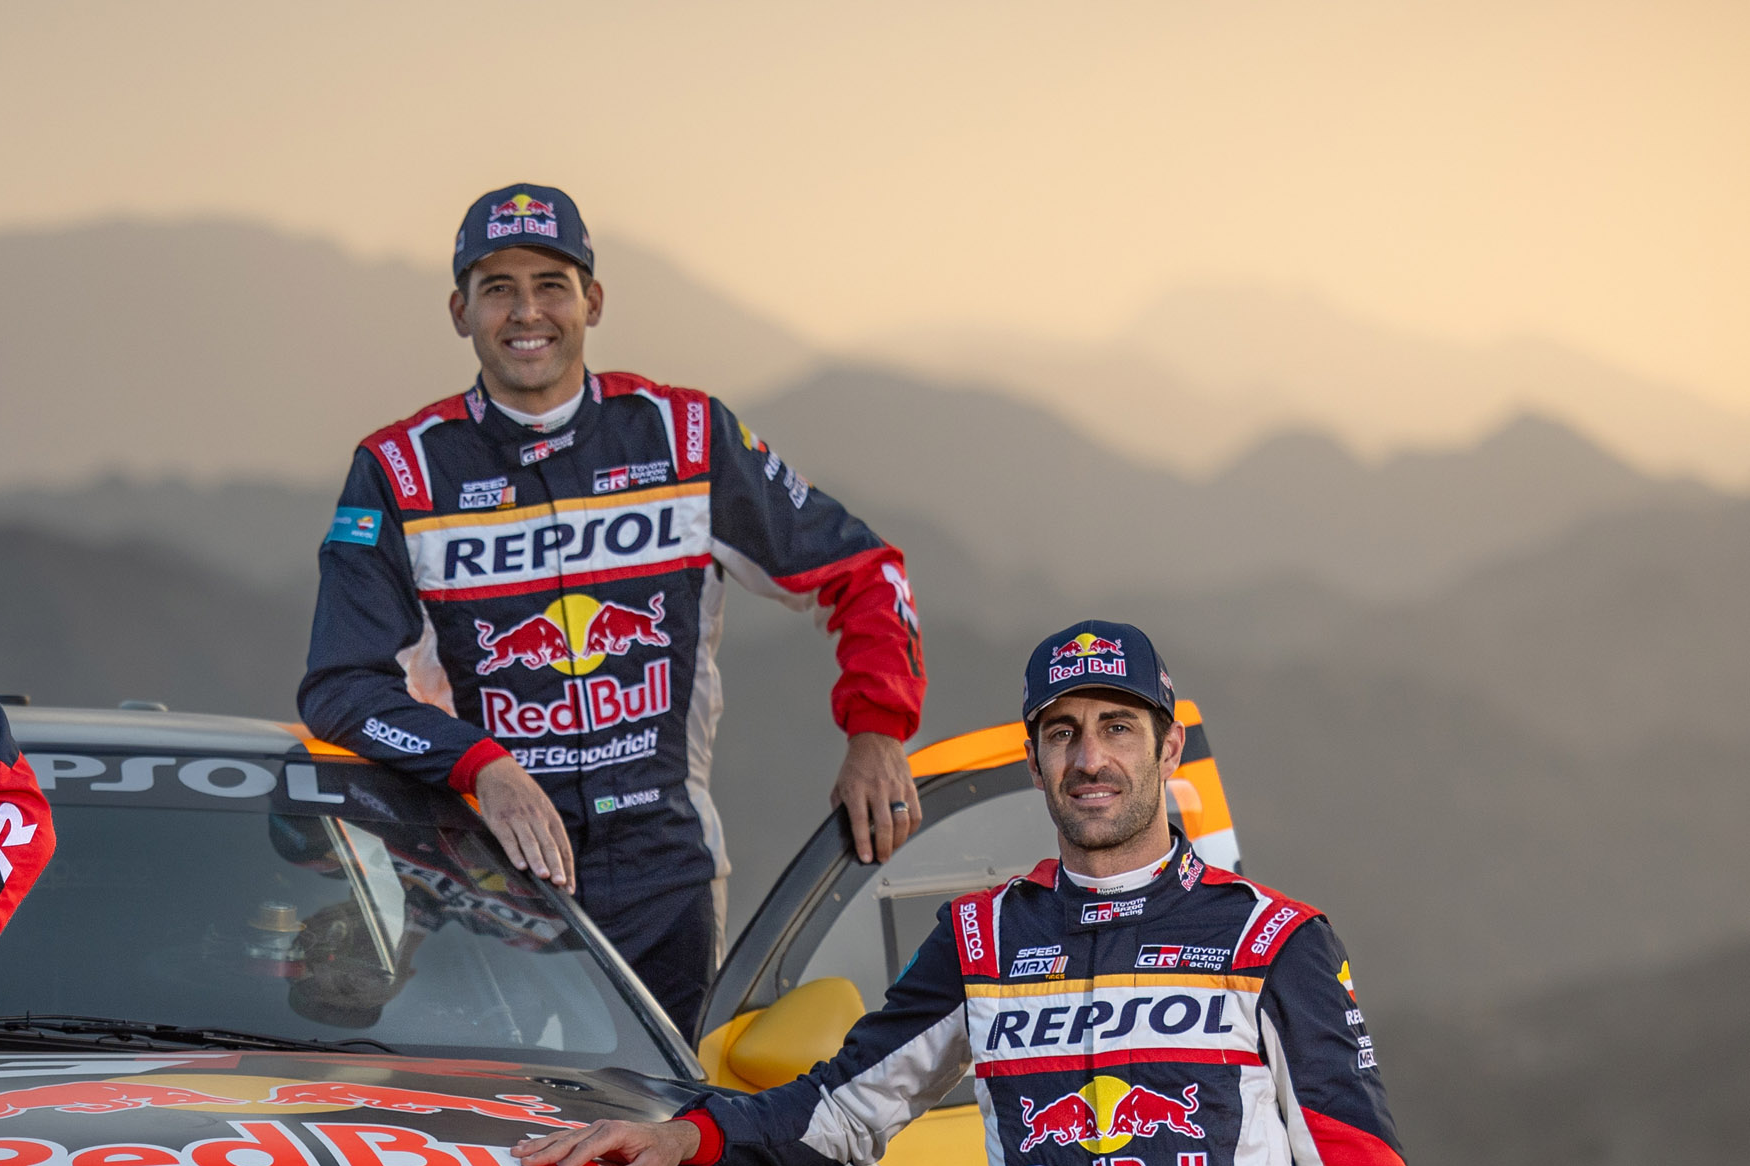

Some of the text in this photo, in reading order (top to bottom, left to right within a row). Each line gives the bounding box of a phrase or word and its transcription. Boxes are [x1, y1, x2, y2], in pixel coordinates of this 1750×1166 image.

[487, 217, 558, 239] Red Bull
[687, 402, 704, 464] sparco
[378, 439, 417, 498] sparco
[462, 477, 508, 493] SPEED
[444, 506, 681, 580] REPSOL
[1049, 657, 1127, 684] Red Bull
[480, 658, 671, 738] Red Bull
[361, 716, 431, 754] sparco
[1113, 897, 1146, 907] TOYOTA
[1113, 904, 1144, 912] GAZOO
[1113, 909, 1143, 918] Racing
[959, 903, 984, 963] sparco
[1251, 907, 1298, 956] sparco
[1016, 945, 1061, 958] SPEED
[1183, 953, 1225, 962] GAZOO
[1185, 946, 1231, 955] TOYOTA
[1011, 959, 1054, 976] MAX
[1181, 960, 1222, 970] Racing
[986, 994, 1233, 1050] REPSOL
